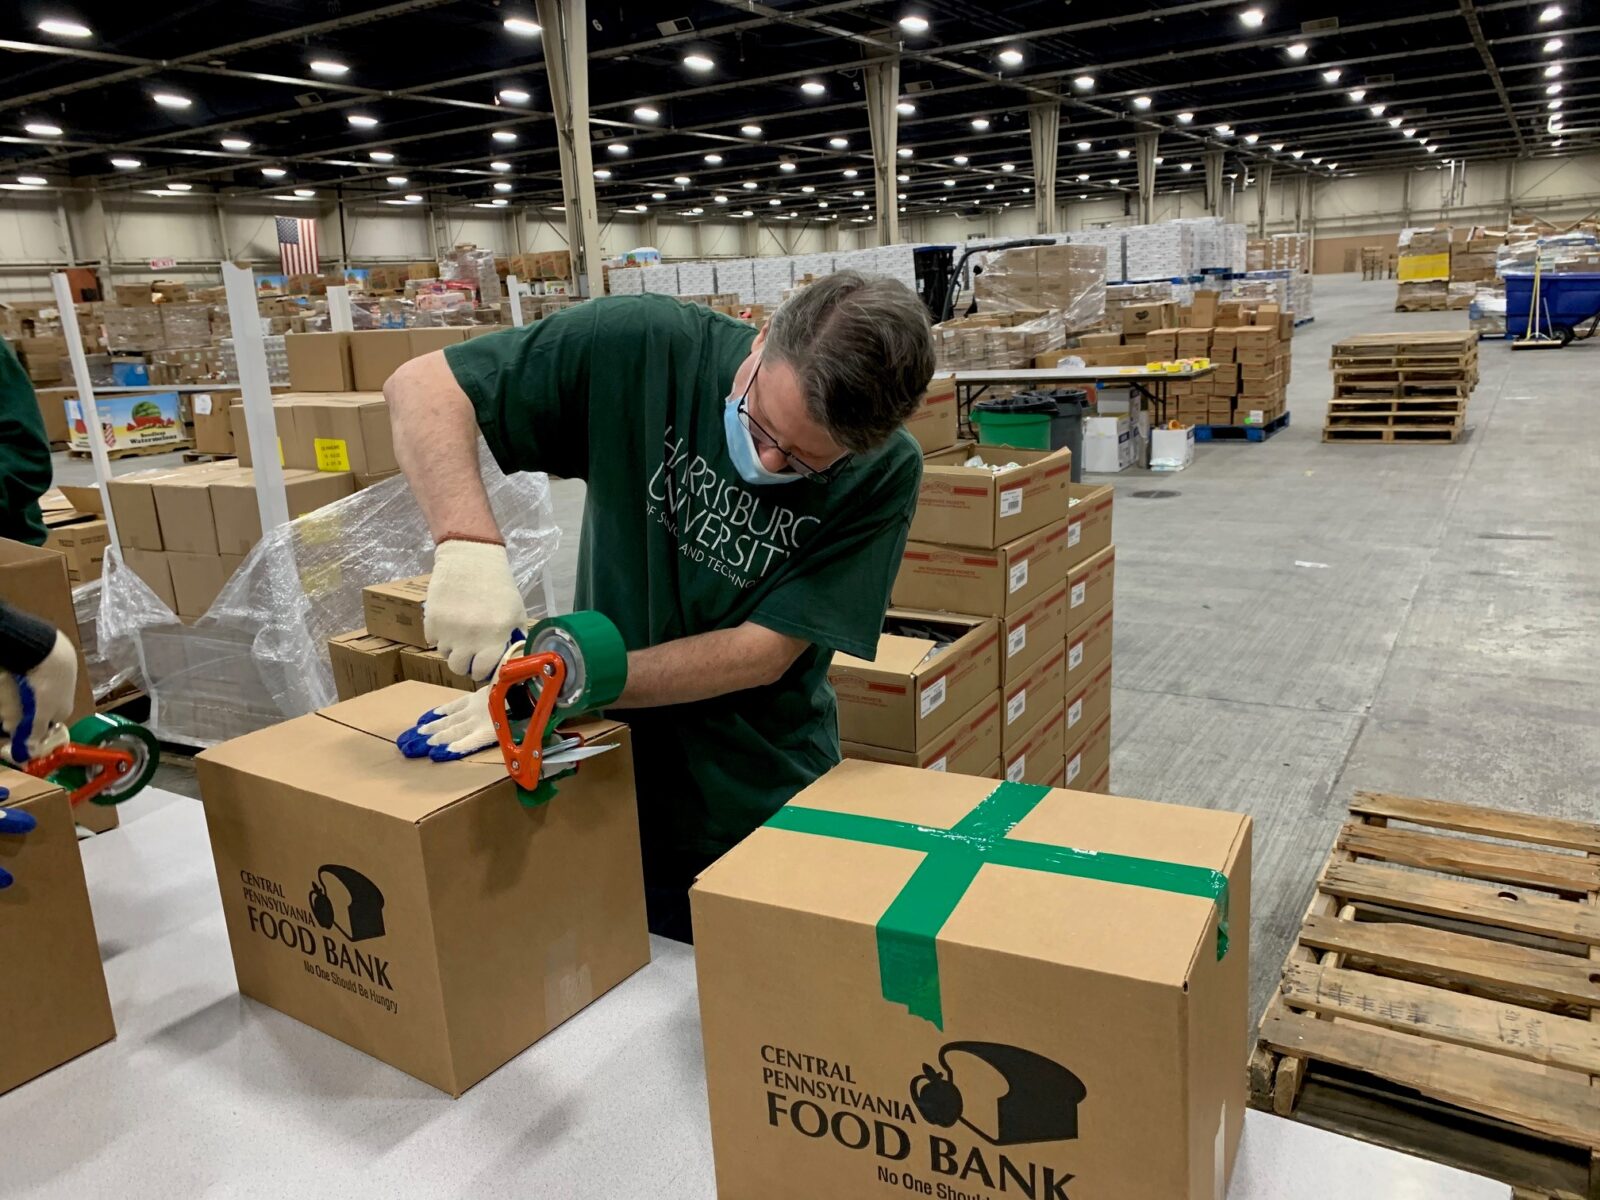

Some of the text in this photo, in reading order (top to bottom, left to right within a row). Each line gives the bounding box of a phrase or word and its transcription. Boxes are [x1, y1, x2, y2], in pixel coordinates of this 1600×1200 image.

[130, 434, 177, 444] Watermelons
[648, 462, 791, 578] UNIVERSIT
[678, 543, 705, 562] AND
[240, 869, 285, 898] CENTRAL
[243, 887, 316, 928] PENNSYLVANIA
[248, 905, 394, 991] FOOD BANK
[303, 960, 398, 1014] No One Should Be Hungry
[760, 1044, 857, 1085] CENTRAL
[762, 1066, 917, 1125] PENNSYLVANIA
[767, 1090, 1077, 1200] FOOD BANK
[877, 1165, 990, 1200] No One Sho
